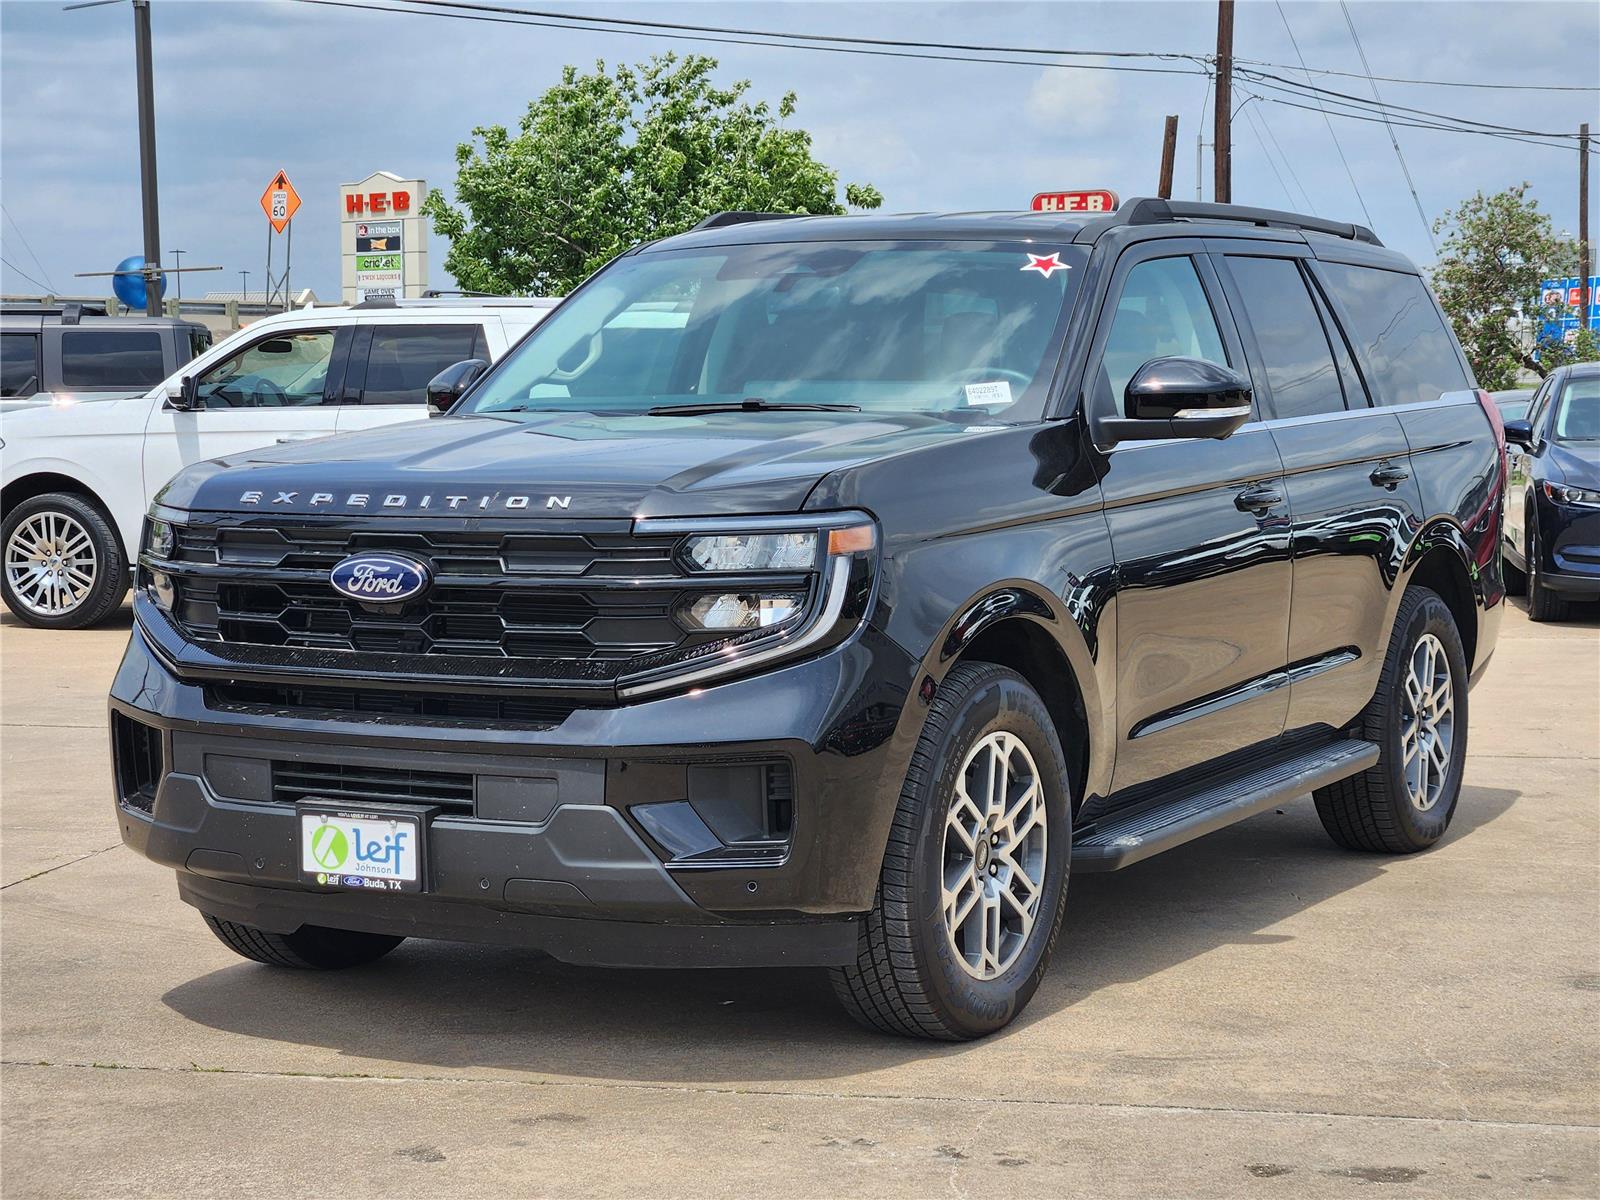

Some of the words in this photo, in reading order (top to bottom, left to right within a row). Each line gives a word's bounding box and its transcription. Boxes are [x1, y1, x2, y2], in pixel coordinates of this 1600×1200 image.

[273, 205, 286, 217] 60
[375, 225, 386, 234] the
[387, 225, 400, 233] box
[363, 257, 396, 268] cricket
[239, 491, 574, 510] EXPEDITION
[347, 564, 403, 595] Ford
[352, 828, 407, 875] leif
[355, 863, 392, 875] Johnson
[364, 879, 387, 889] Buda,
[389, 881, 402, 890] TX
